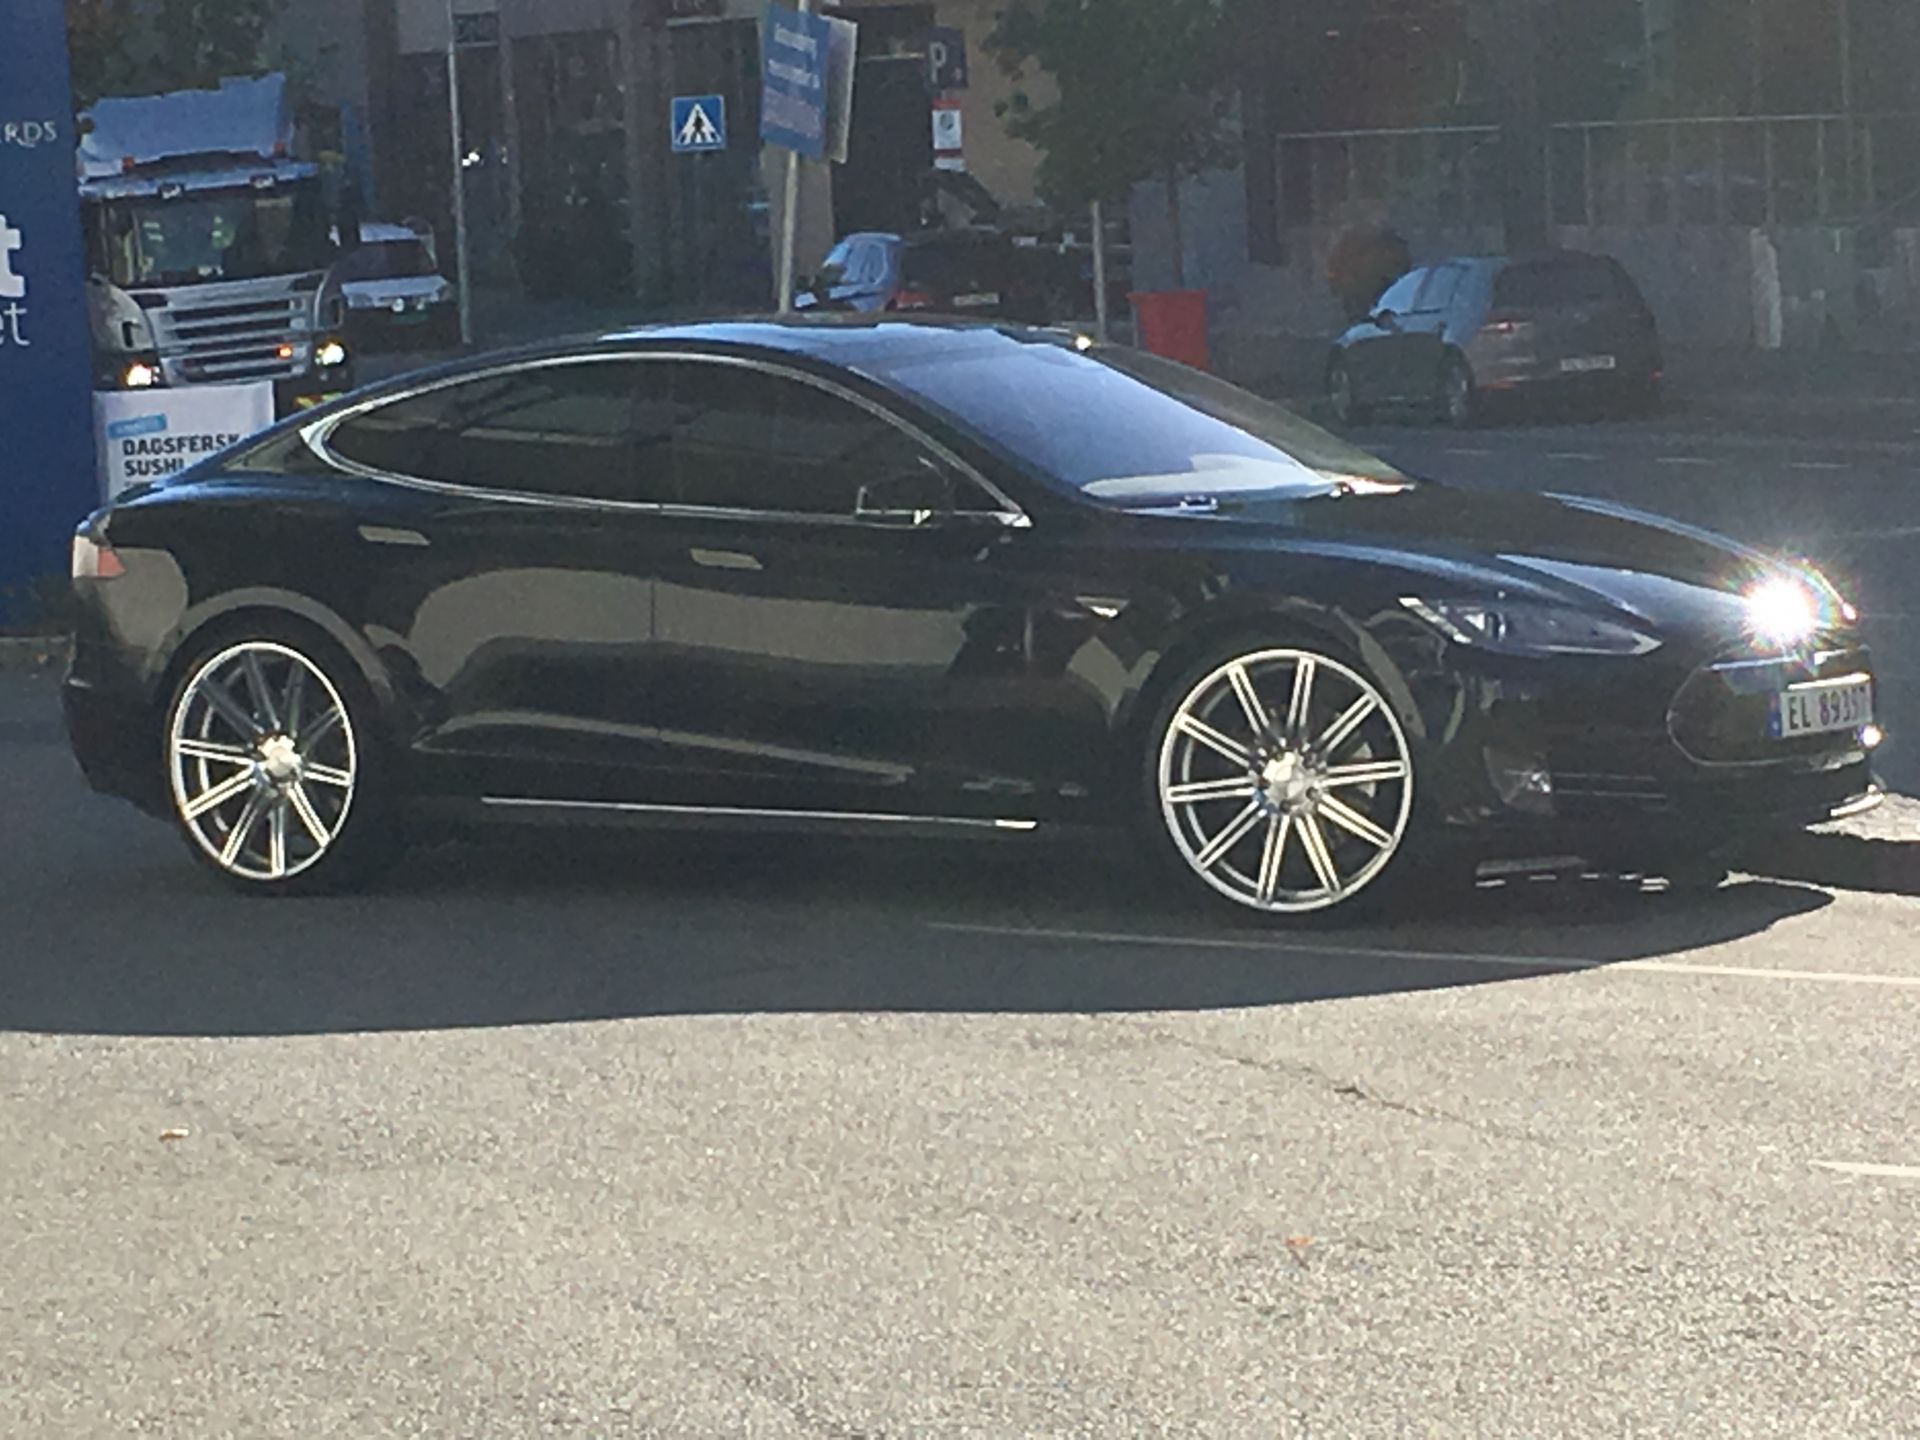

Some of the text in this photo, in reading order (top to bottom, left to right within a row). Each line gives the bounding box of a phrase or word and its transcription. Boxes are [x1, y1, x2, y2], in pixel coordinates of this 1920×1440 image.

[0, 120, 57, 148] RDS
[0, 302, 31, 346] t
[124, 456, 185, 477] SUSHI
[1788, 696, 1811, 730] EL
